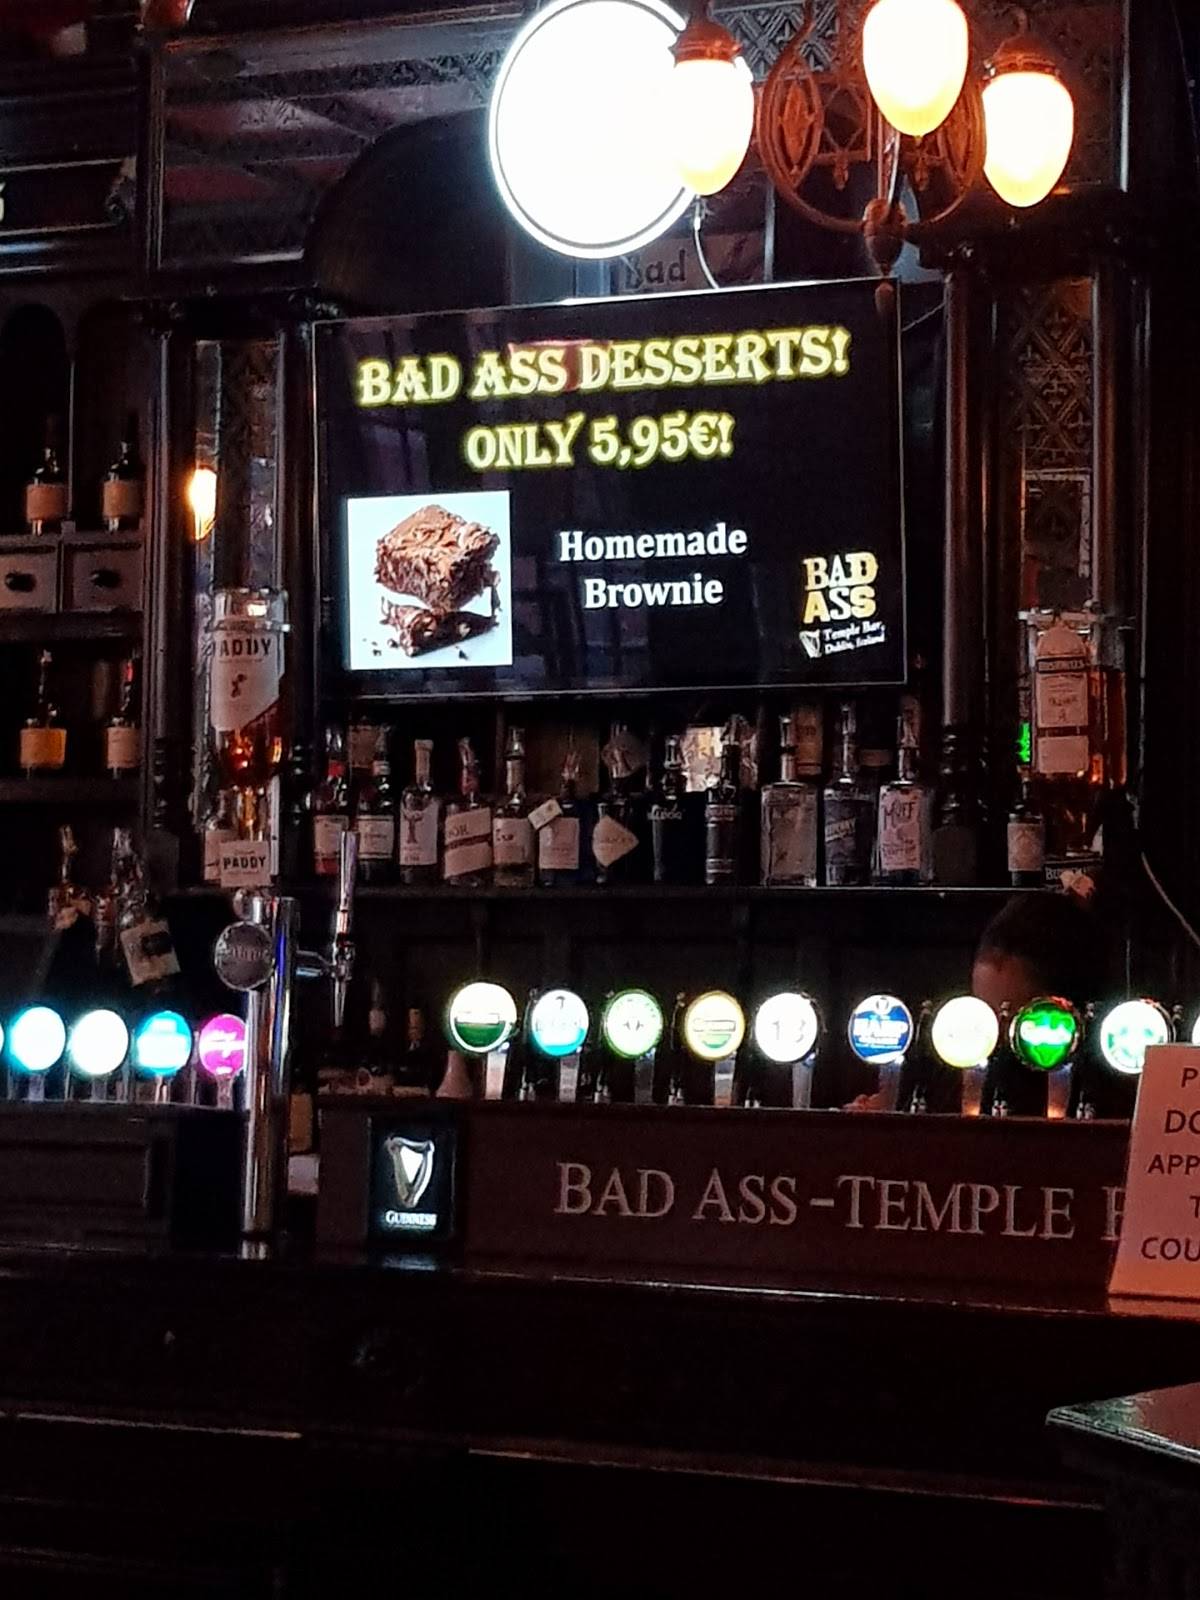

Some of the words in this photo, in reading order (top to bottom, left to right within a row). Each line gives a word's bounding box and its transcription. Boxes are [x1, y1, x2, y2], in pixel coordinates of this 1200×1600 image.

[358, 355, 460, 406] BAD
[470, 347, 567, 398] ASS
[578, 327, 850, 390] DESSERTS!
[464, 412, 584, 470] ONLY
[590, 411, 735, 468] 5,95€!
[559, 522, 748, 562] Homemade
[803, 551, 879, 590] BAD
[583, 573, 723, 609] Brownie
[803, 585, 877, 624] ASS
[1147, 1154, 1200, 1175] APP
[553, 1161, 675, 1218] BAD
[691, 1167, 798, 1226] ASS
[1141, 1237, 1200, 1262] COU
